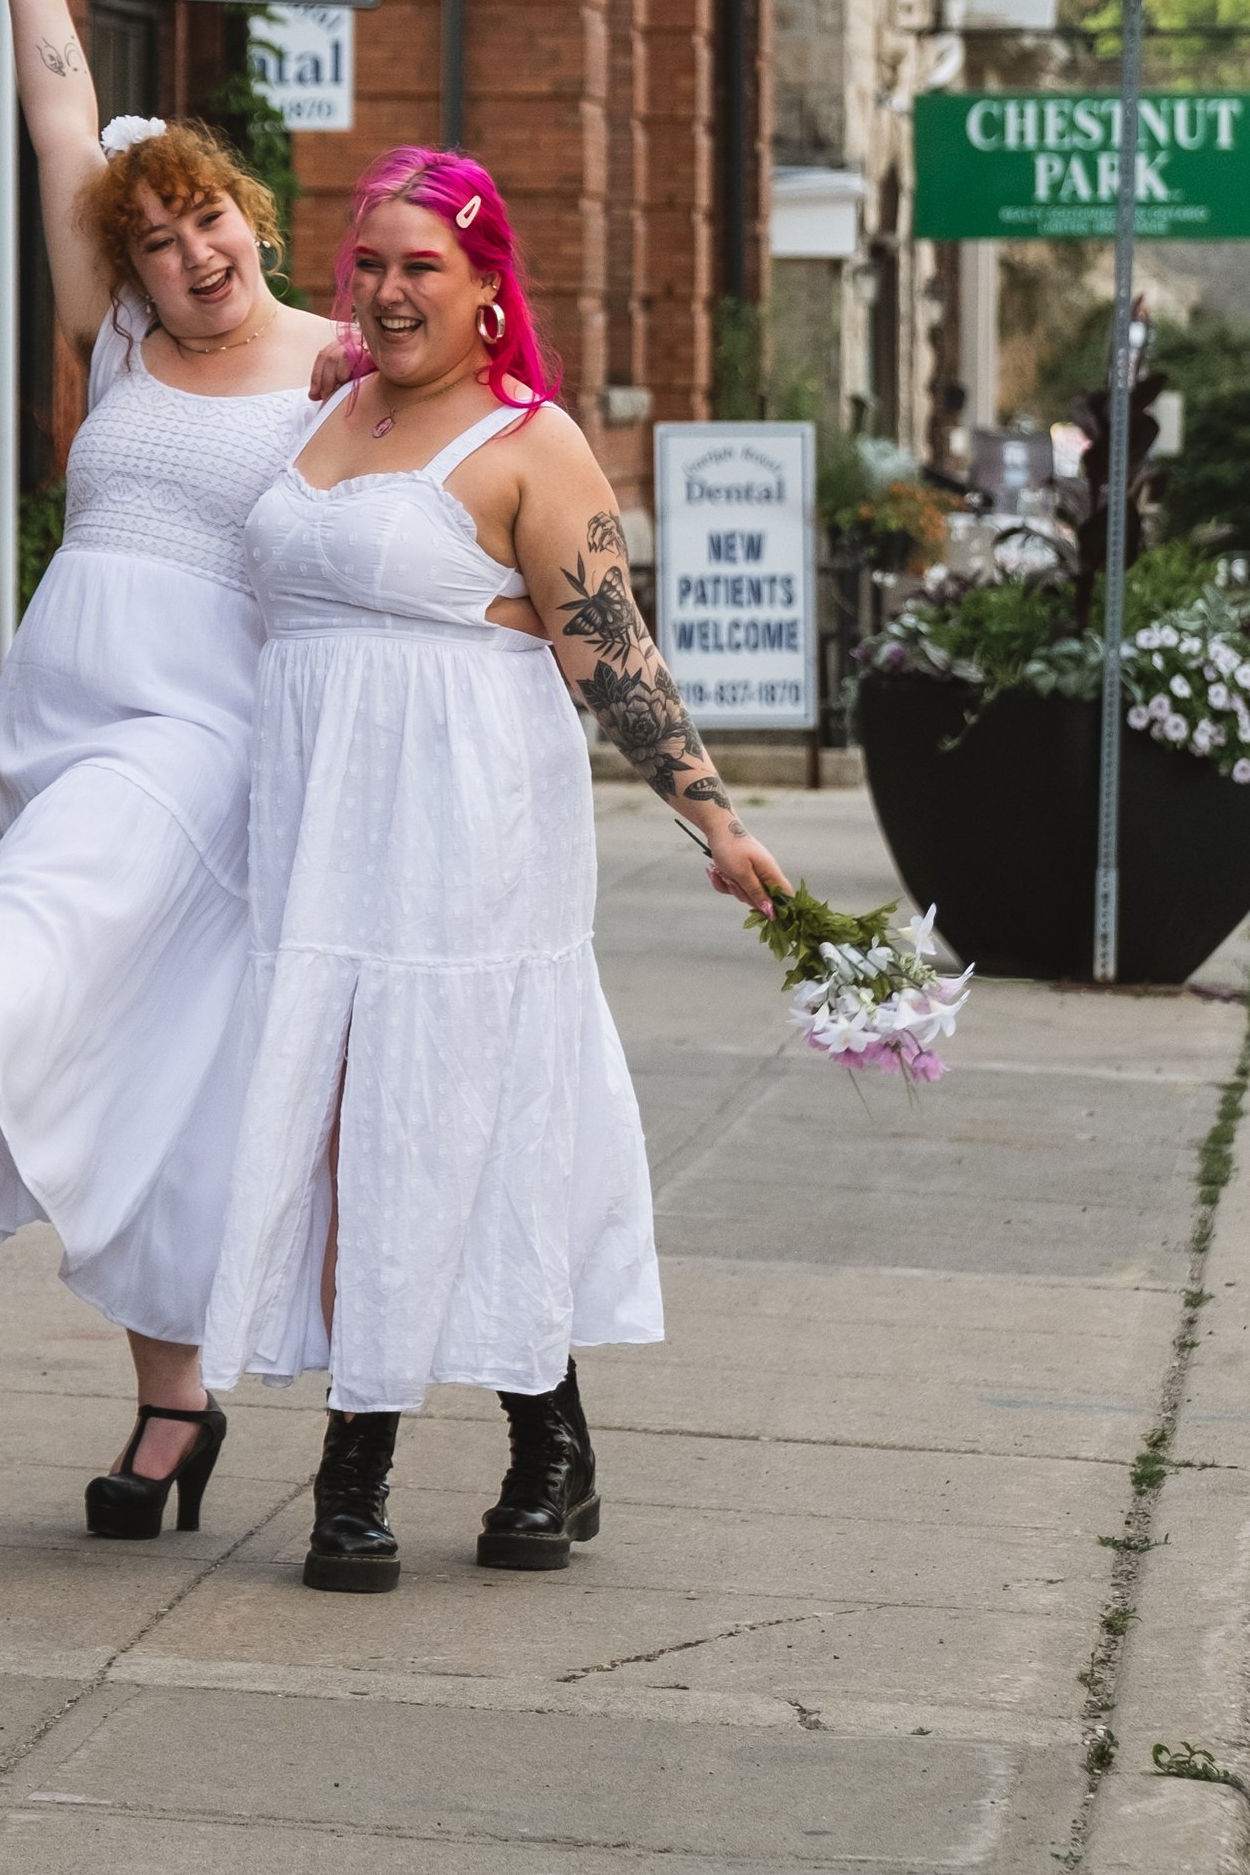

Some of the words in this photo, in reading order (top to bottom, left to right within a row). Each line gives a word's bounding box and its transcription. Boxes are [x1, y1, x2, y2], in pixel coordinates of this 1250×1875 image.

[965, 98, 1243, 151] CHESTNUT
[1034, 151, 1171, 203] PARK
[685, 475, 785, 504] Dental
[708, 530, 766, 564] NEW
[676, 575, 796, 608] PATIENTS
[673, 618, 800, 653] WELCOME
